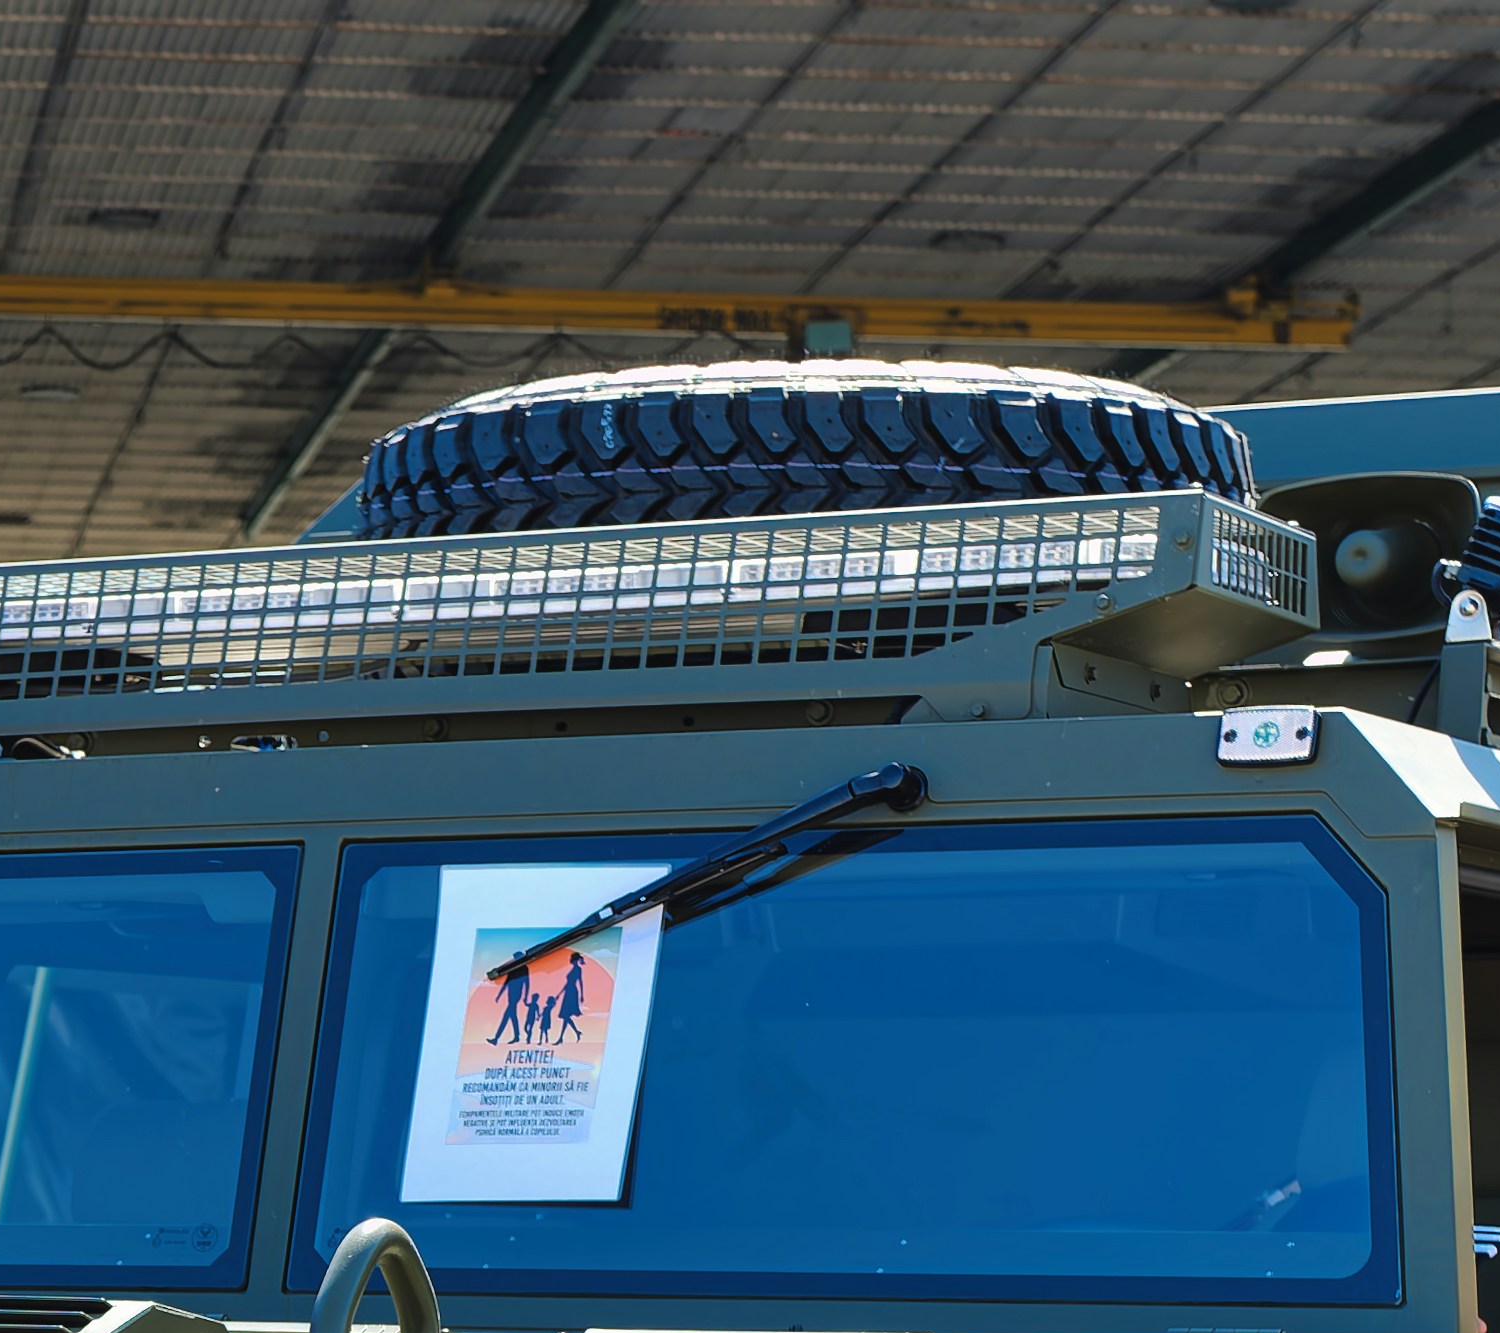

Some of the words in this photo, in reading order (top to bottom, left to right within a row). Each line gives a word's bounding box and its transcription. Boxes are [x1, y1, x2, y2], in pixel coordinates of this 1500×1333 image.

[511, 1067, 538, 1079] ACEST
[540, 1067, 571, 1079] PUNCT
[577, 1082, 589, 1092] FIE
